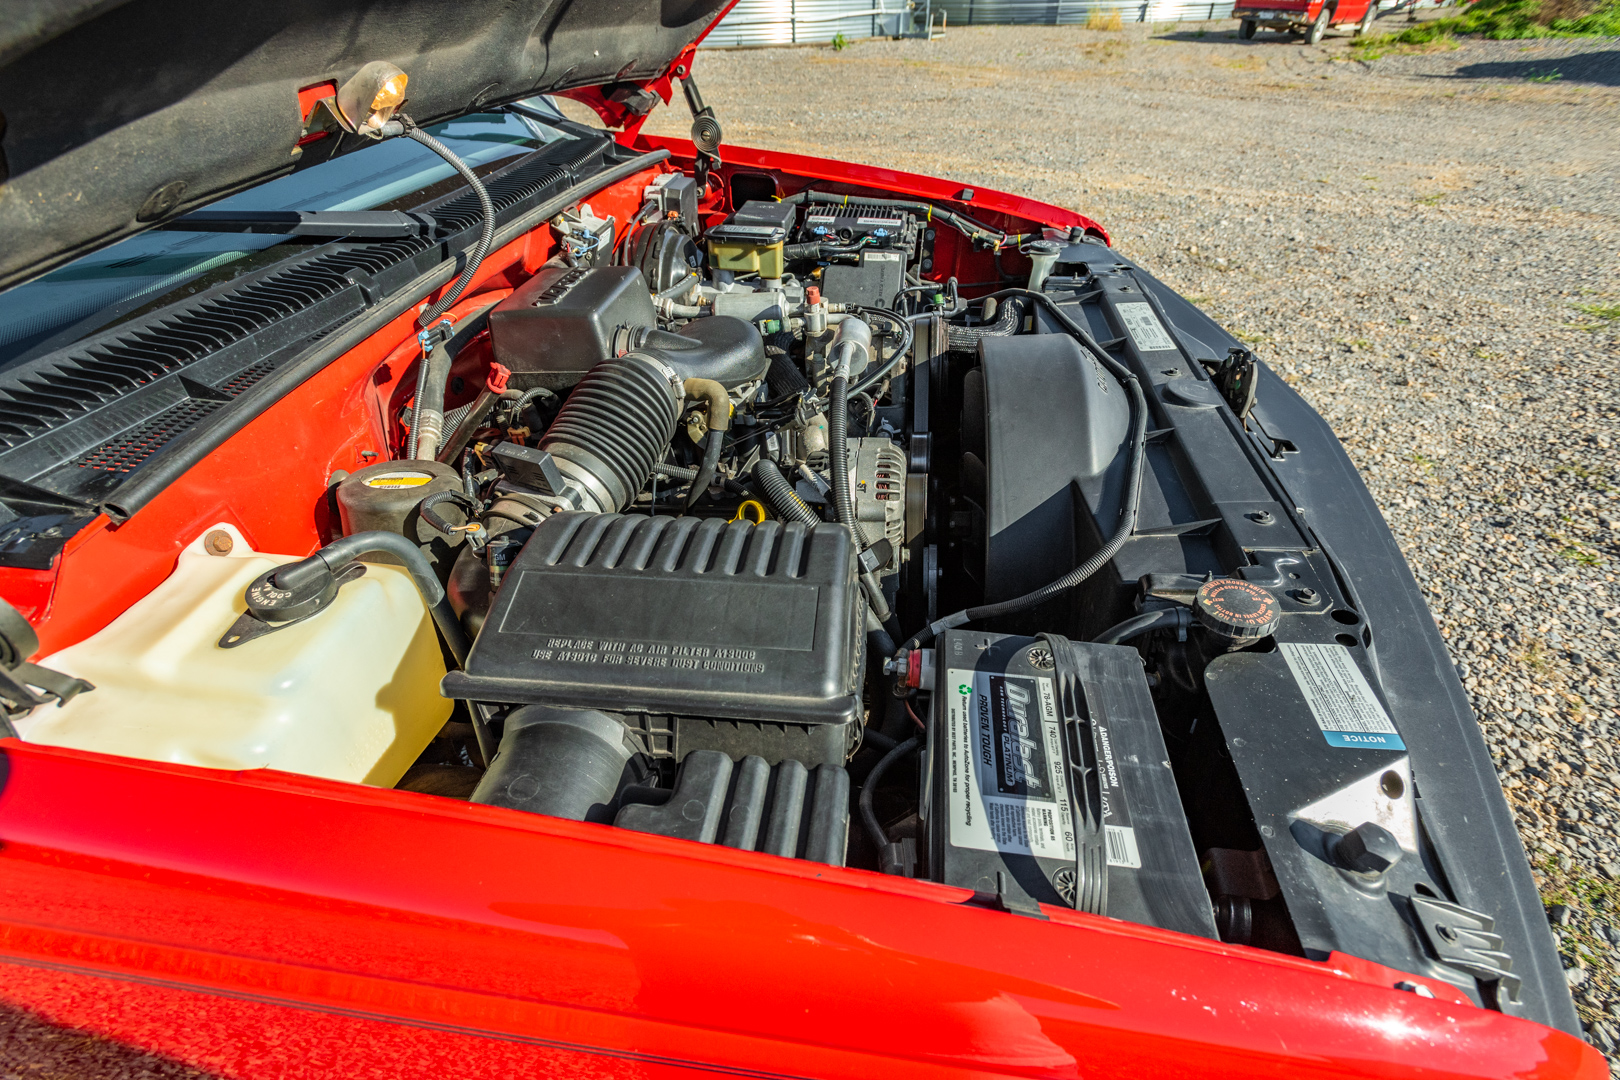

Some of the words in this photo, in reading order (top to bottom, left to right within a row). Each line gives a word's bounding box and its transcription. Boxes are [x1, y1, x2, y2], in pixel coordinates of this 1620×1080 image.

[252, 587, 277, 606] ENGINE
[546, 638, 594, 650] REPLACE
[598, 641, 626, 652] WITH
[629, 643, 644, 653] AC
[647, 644, 668, 655] AIR
[671, 646, 710, 658] FILTER
[531, 649, 553, 660] USE
[602, 654, 623, 664] FOR
[625, 655, 668, 667] SEVERE
[671, 658, 700, 670] DUST
[702, 661, 765, 673] CONDITIONS
[978, 693, 989, 730] PROVEN
[1042, 692, 1054, 716] 78-AGM
[1003, 680, 1042, 788] Duralast
[1048, 726, 1056, 738] 740
[1342, 734, 1386, 743] NOTICE
[981, 732, 992, 766] TOUGH
[1002, 735, 1013, 784] PLATINUM
[1053, 760, 1062, 774] 925
[963, 781, 971, 800] proper
[964, 800, 972, 826] recycling
[1059, 798, 1068, 812] 115
[1063, 830, 1073, 842] 60
